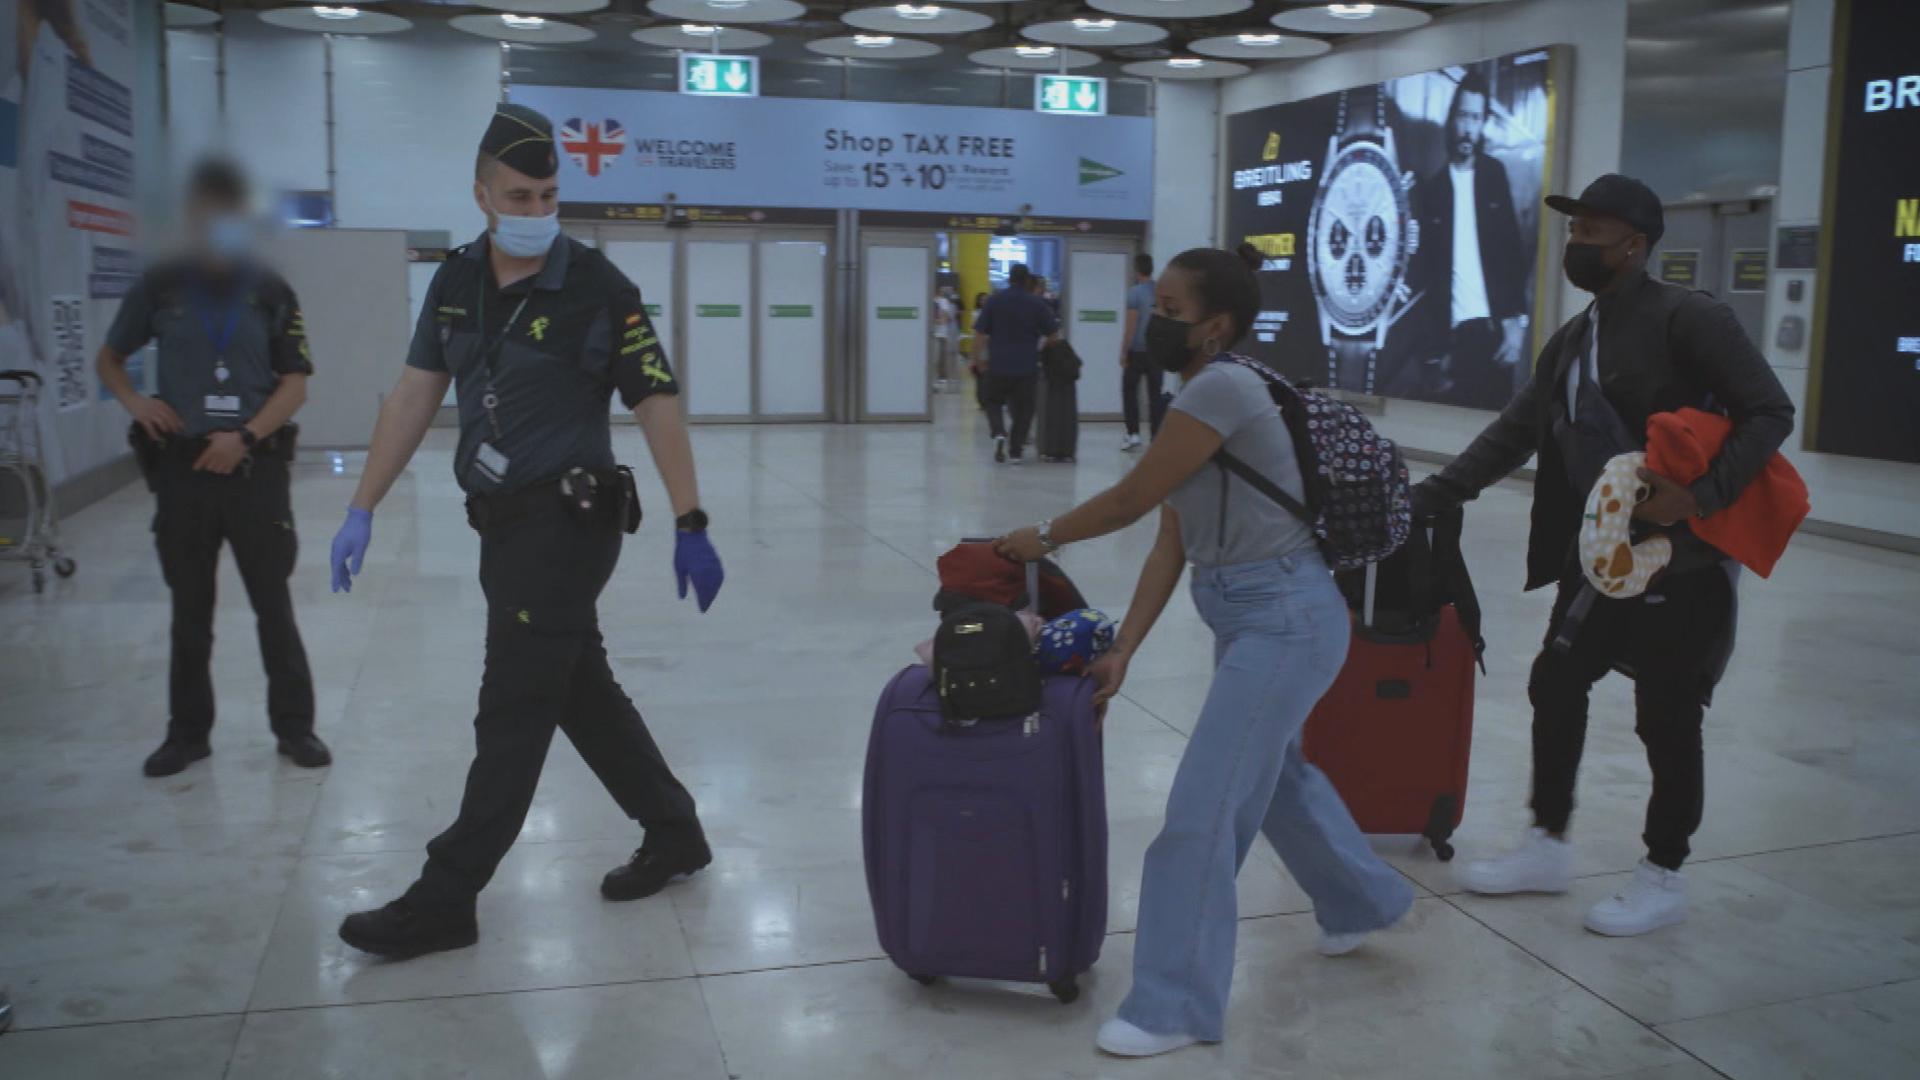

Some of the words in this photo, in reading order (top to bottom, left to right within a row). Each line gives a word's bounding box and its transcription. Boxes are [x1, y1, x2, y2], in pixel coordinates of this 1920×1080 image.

[634, 138, 736, 157] WELCOME
[824, 129, 894, 156] Shop
[902, 132, 949, 155] TAX
[957, 135, 1016, 157] FREE
[1233, 160, 1312, 190] BREITLING
